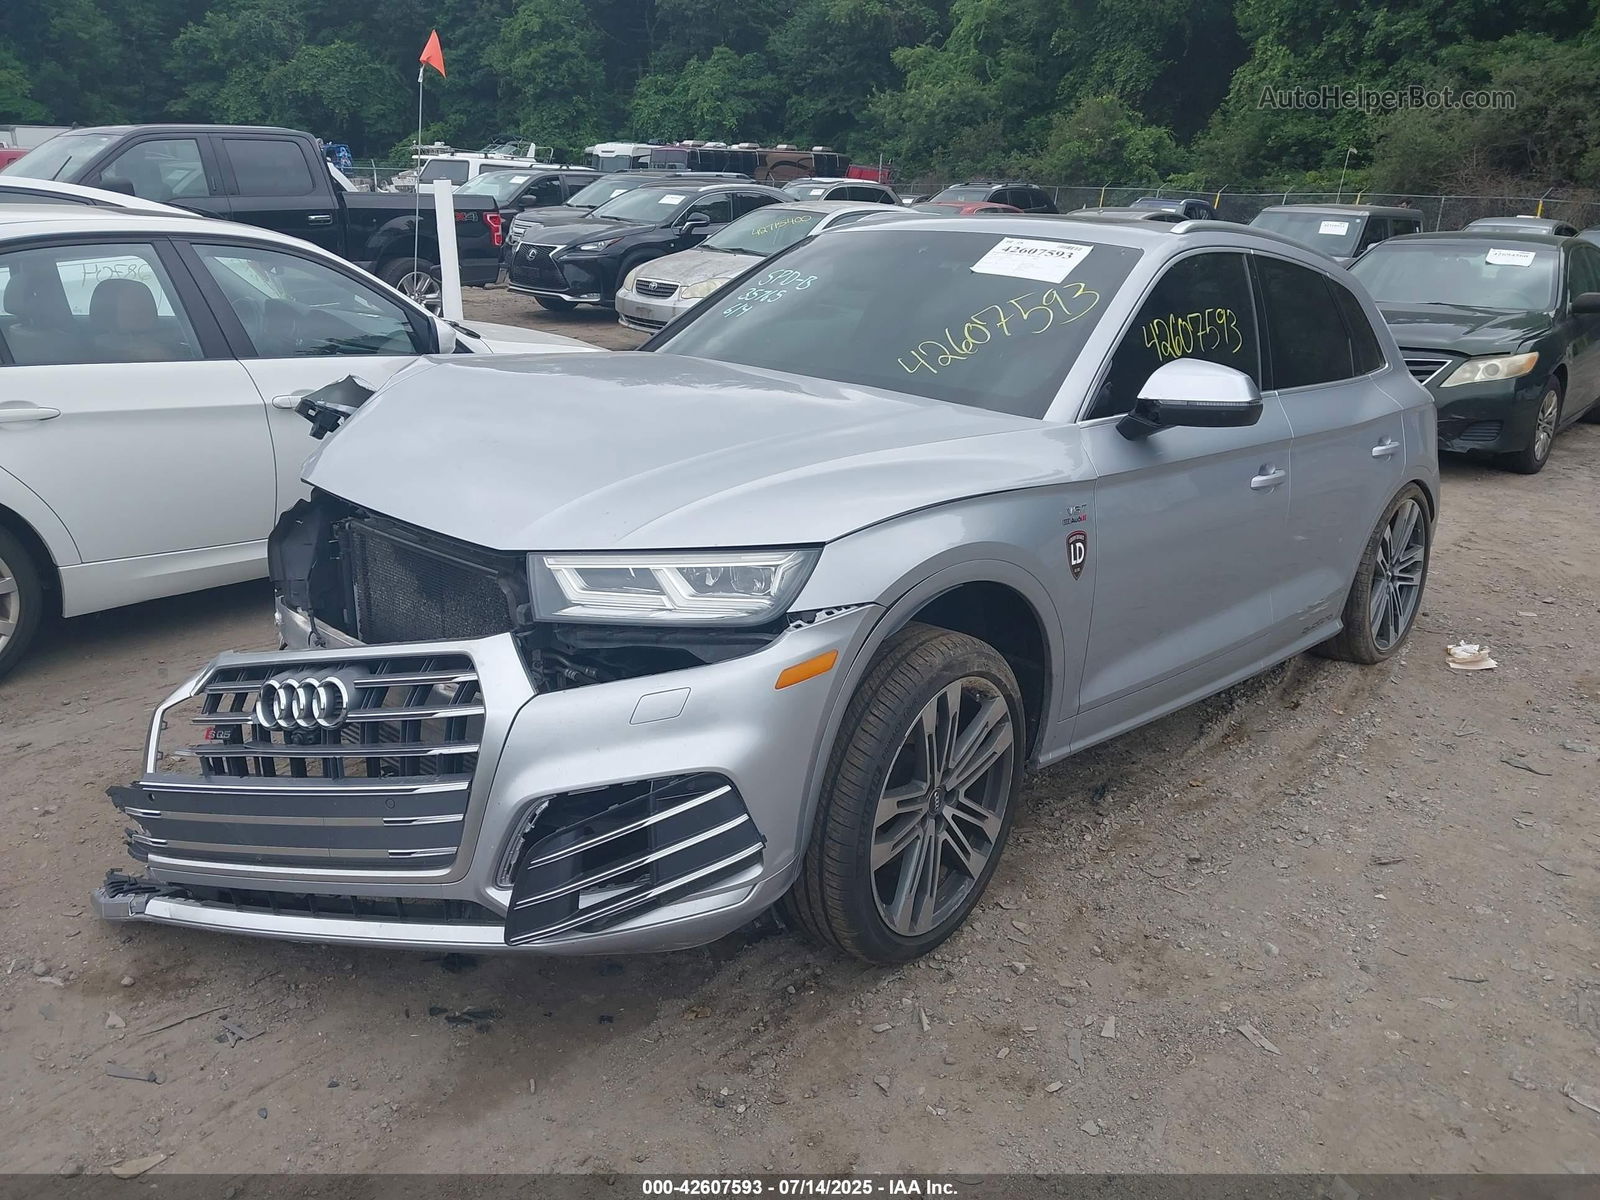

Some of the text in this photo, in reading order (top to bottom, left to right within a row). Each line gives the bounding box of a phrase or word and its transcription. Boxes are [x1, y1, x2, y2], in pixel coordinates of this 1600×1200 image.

[1001, 245, 1074, 259] 42607593
[897, 286, 1100, 374] 42607593
[1142, 308, 1243, 361] 42607593
[1070, 542, 1085, 565] LD
